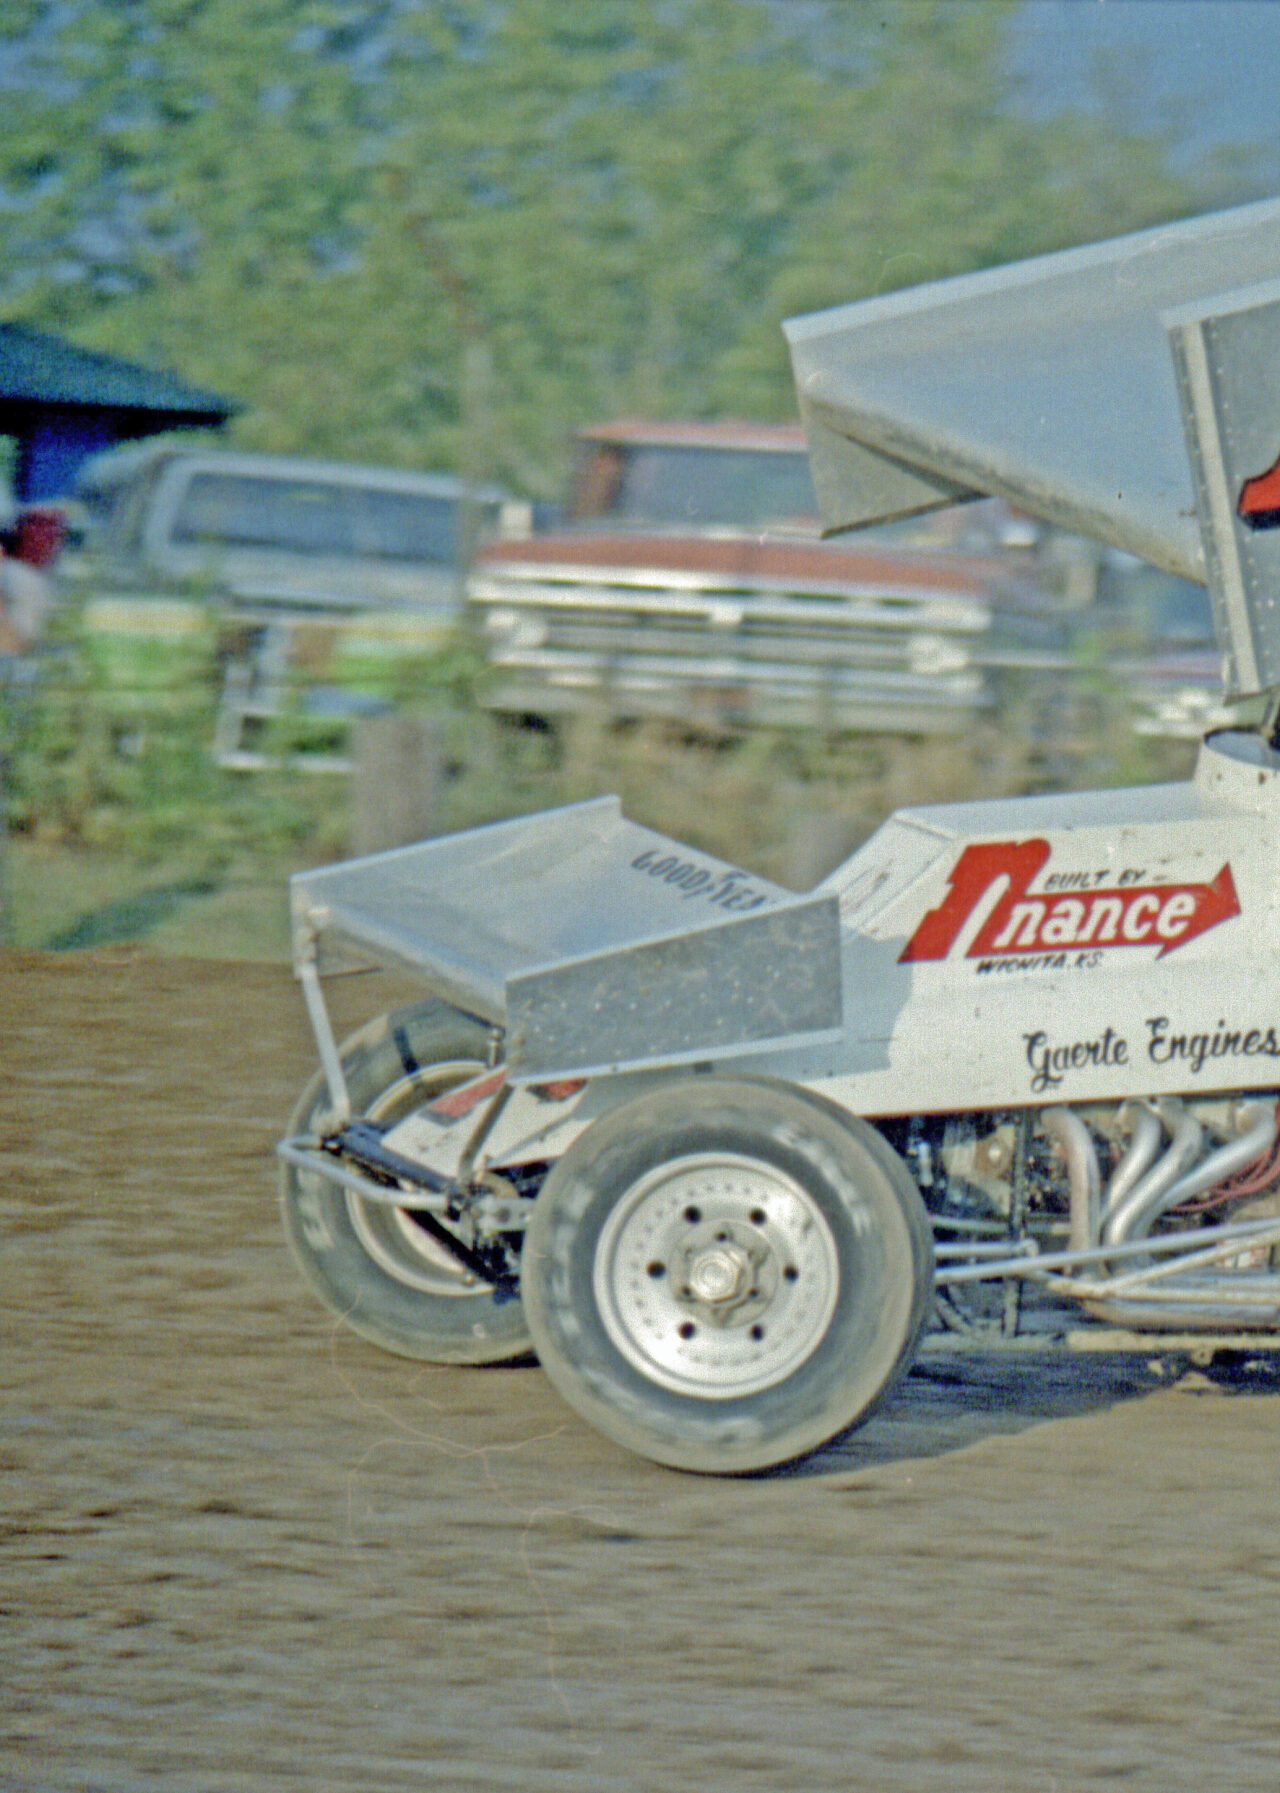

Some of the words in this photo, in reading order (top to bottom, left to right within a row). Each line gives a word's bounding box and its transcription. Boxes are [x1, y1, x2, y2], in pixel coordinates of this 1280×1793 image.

[1044, 869, 1110, 892] BUILT
[1119, 869, 1146, 886] BY
[992, 893, 1196, 950] nance
[1023, 1030, 1129, 1093] Gaerte
